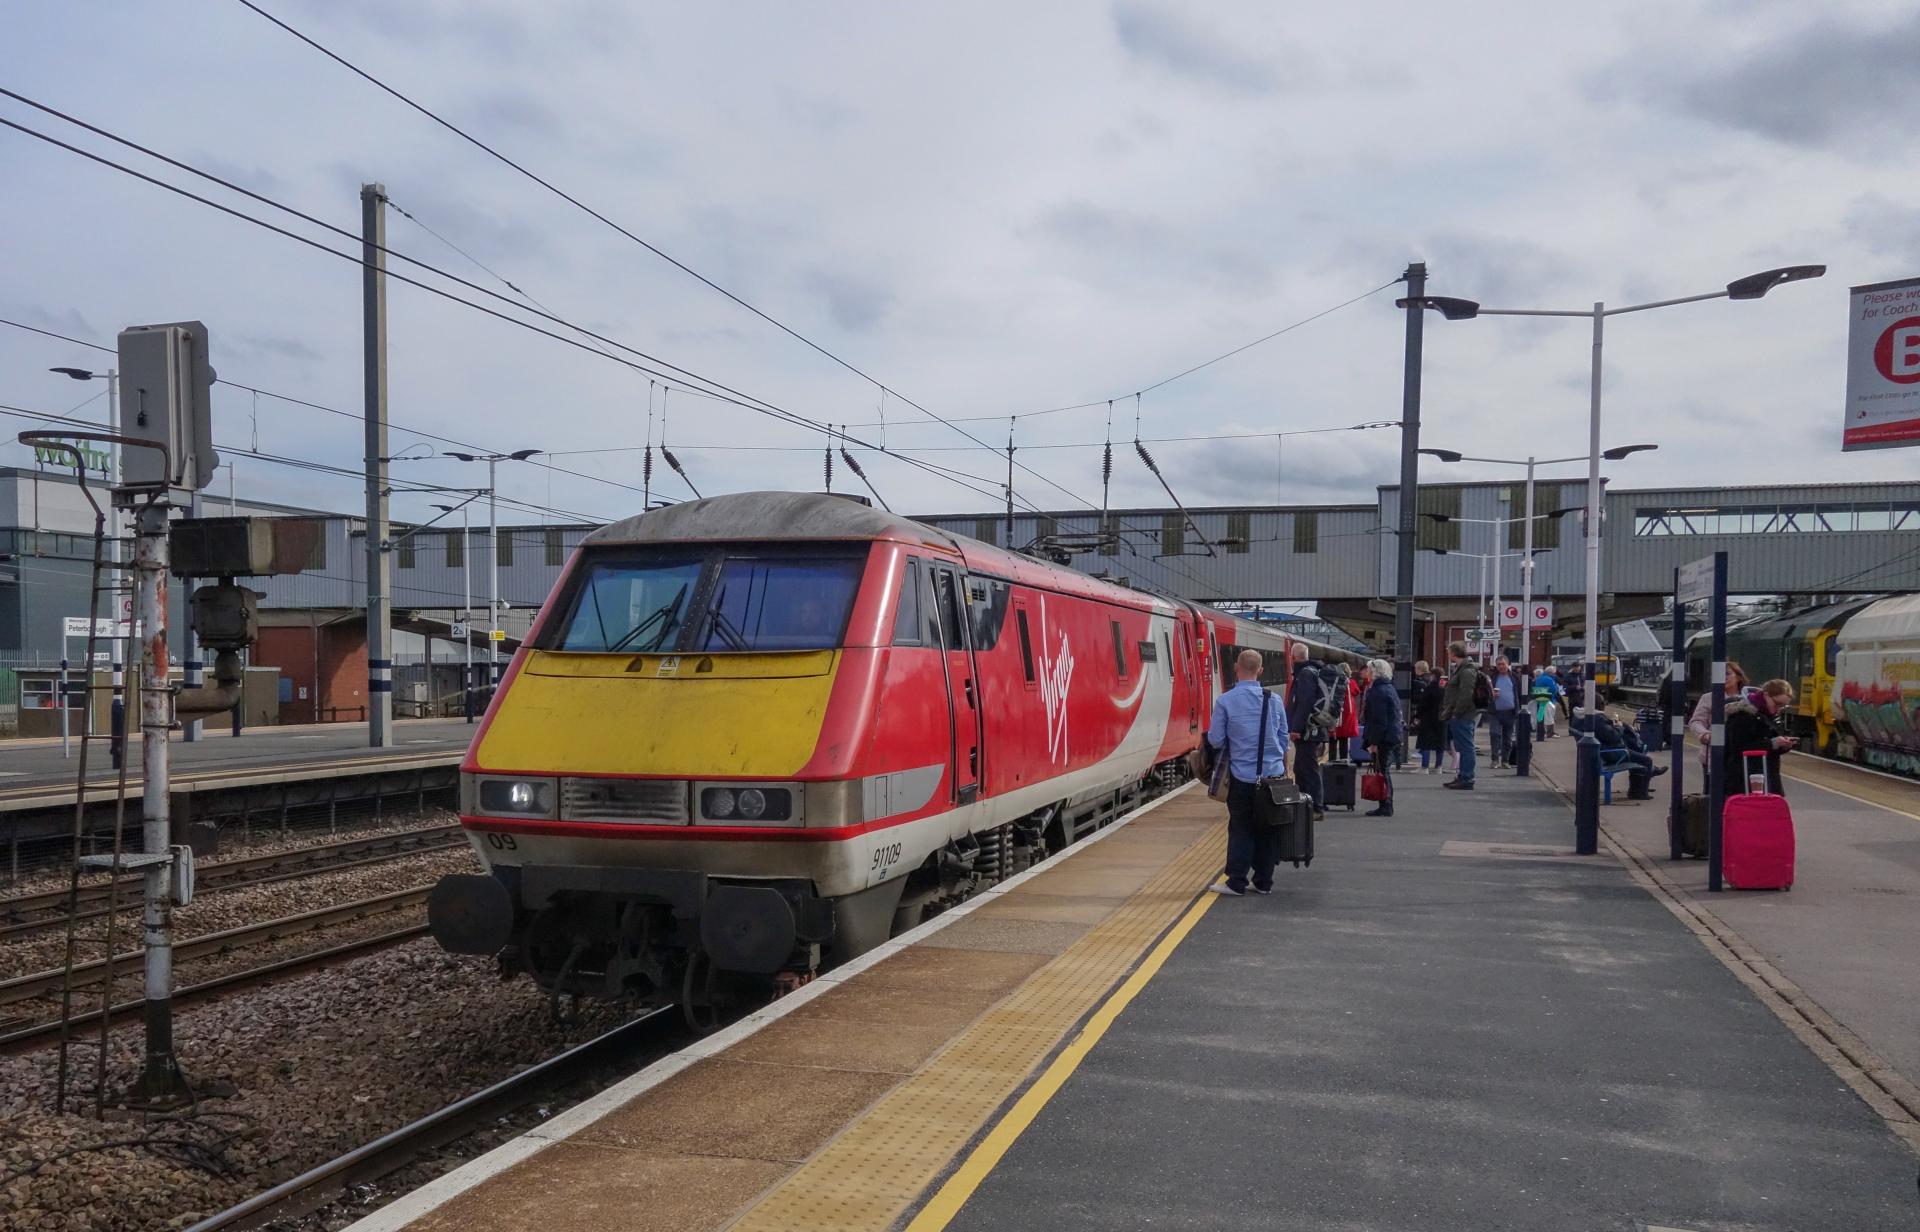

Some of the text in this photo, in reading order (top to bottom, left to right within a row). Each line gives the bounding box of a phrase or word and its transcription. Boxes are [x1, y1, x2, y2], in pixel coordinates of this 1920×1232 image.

[1862, 292, 1903, 305] Please
[1862, 302, 1919, 321] for Coach
[1892, 325, 1920, 376] B
[68, 625, 107, 633] Peterbough
[488, 833, 517, 850] 09
[872, 842, 902, 870] 91109
